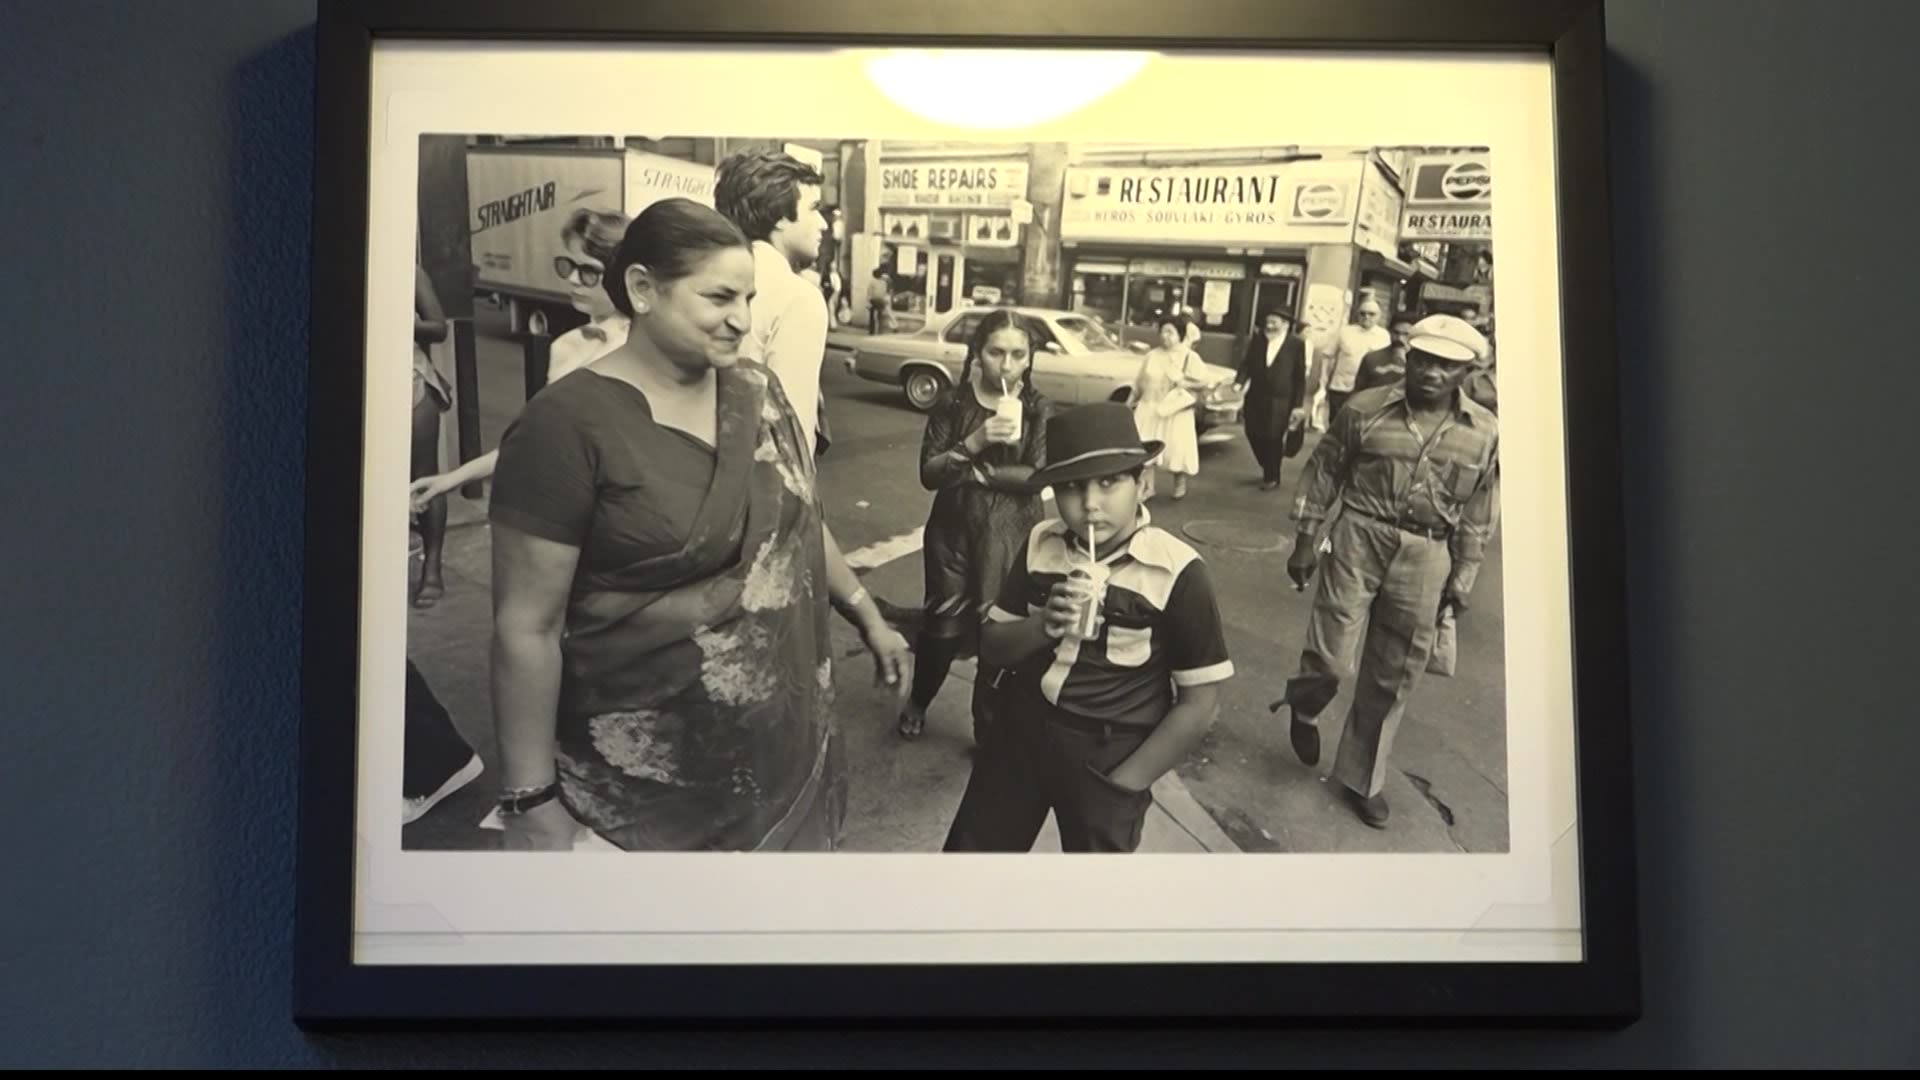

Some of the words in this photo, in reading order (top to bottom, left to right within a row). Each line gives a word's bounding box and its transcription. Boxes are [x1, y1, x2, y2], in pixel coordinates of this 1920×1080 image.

[883, 169, 918, 189] SHOE
[928, 168, 997, 189] REPAIRS
[1120, 175, 1279, 204] RESTAURANT
[1147, 211, 1214, 223] SOUVLAKI
[1224, 211, 1276, 225] GYROS
